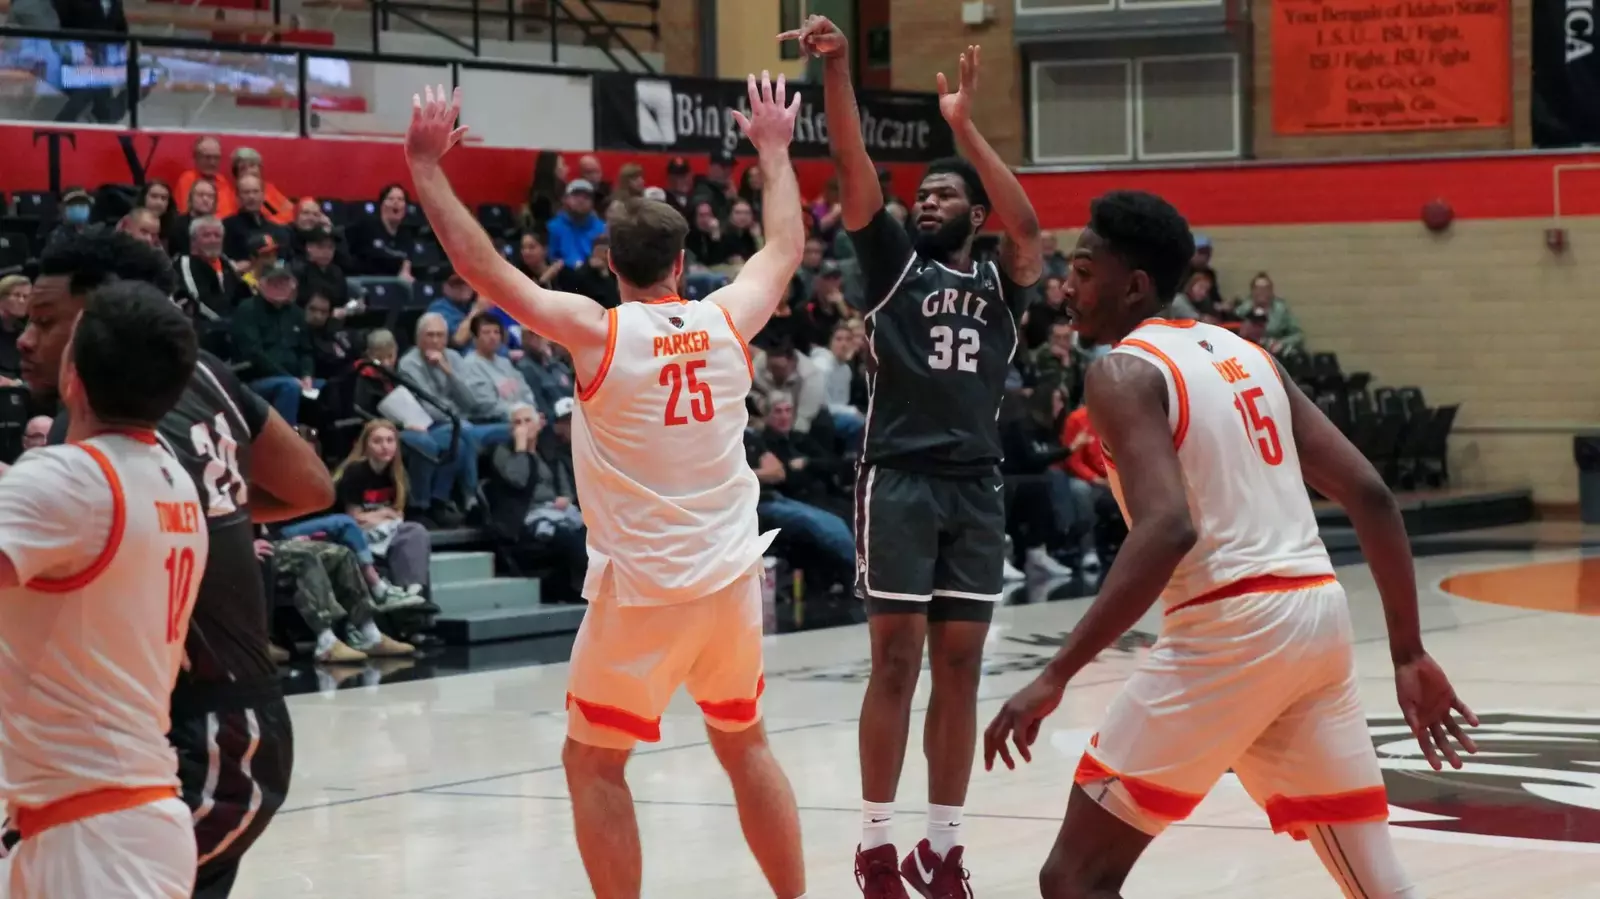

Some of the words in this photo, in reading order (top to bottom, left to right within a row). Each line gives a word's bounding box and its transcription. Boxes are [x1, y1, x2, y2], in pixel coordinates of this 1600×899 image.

[922, 288, 988, 326] GRIZ
[653, 330, 710, 357] PARKER
[928, 325, 981, 373] 32
[659, 360, 714, 426] 25
[1234, 386, 1283, 466] 15
[164, 546, 194, 644] 10
